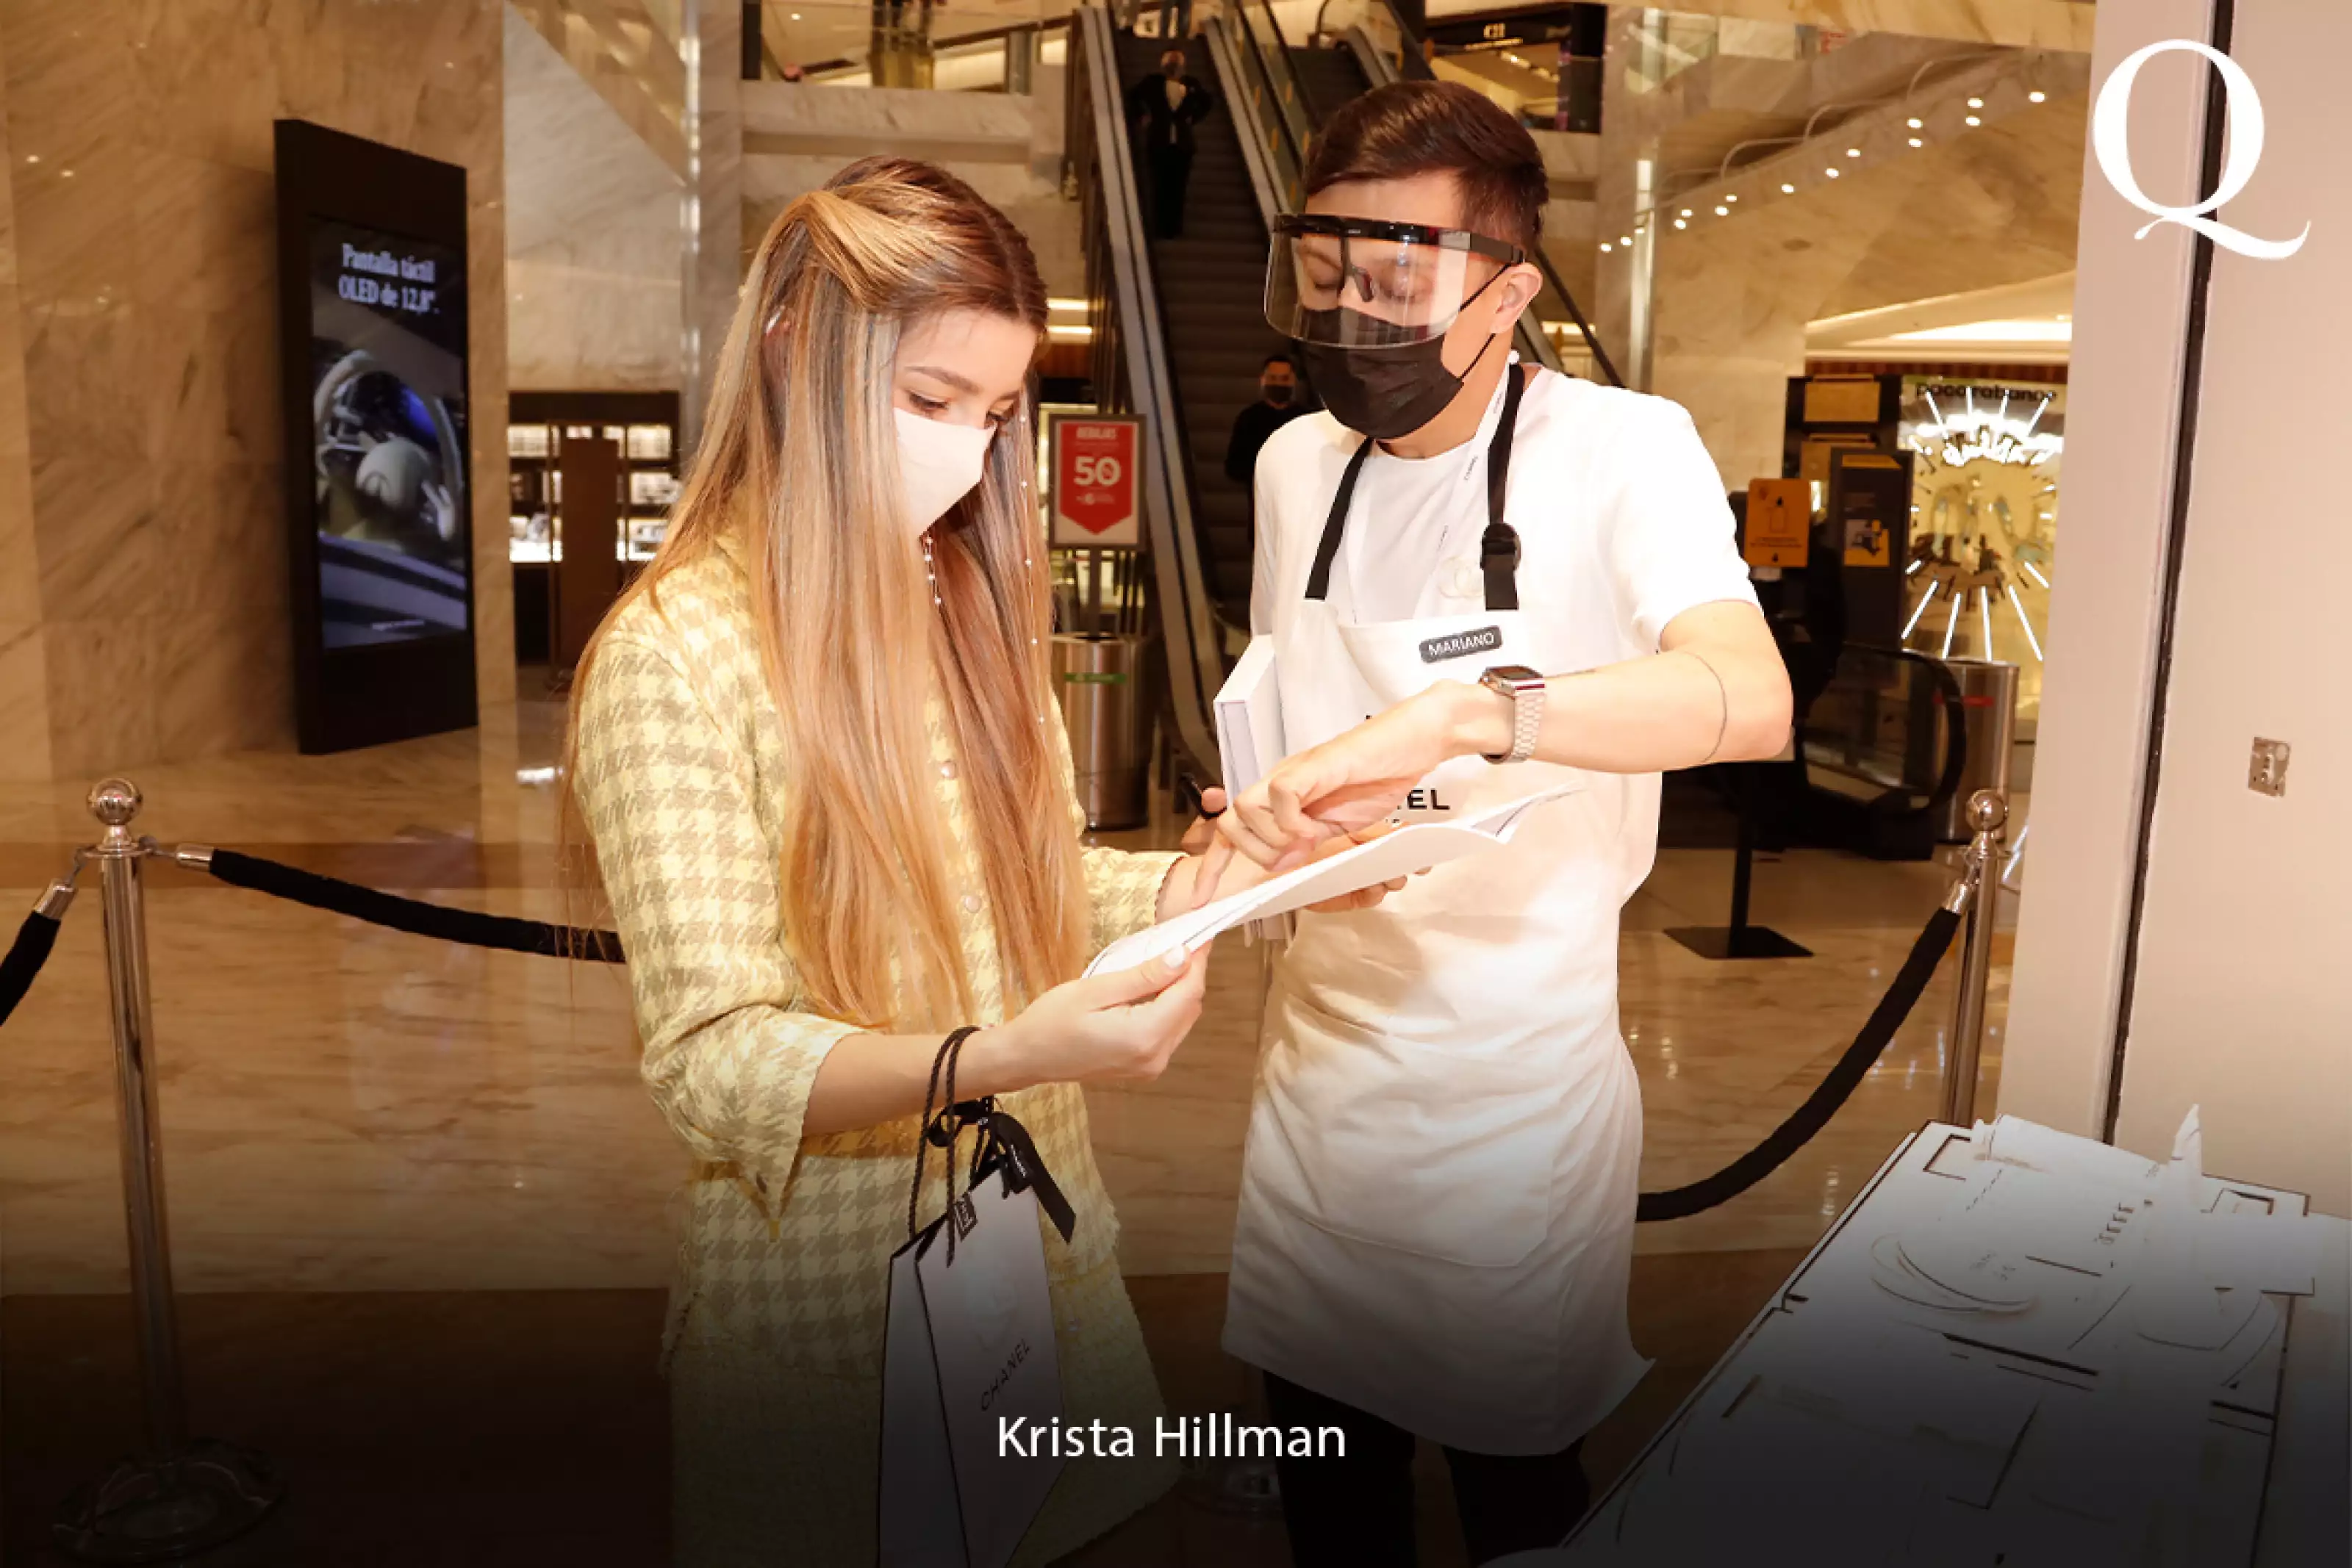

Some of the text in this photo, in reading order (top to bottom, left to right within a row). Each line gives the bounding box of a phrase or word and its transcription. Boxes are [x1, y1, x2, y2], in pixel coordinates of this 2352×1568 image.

[342, 242, 398, 276] Pantalla
[339, 274, 379, 303] OLED
[381, 281, 398, 307] de
[1073, 456, 1122, 486] 50
[1428, 631, 1494, 656] MARIANO
[980, 1338, 1030, 1411] CHANEL
